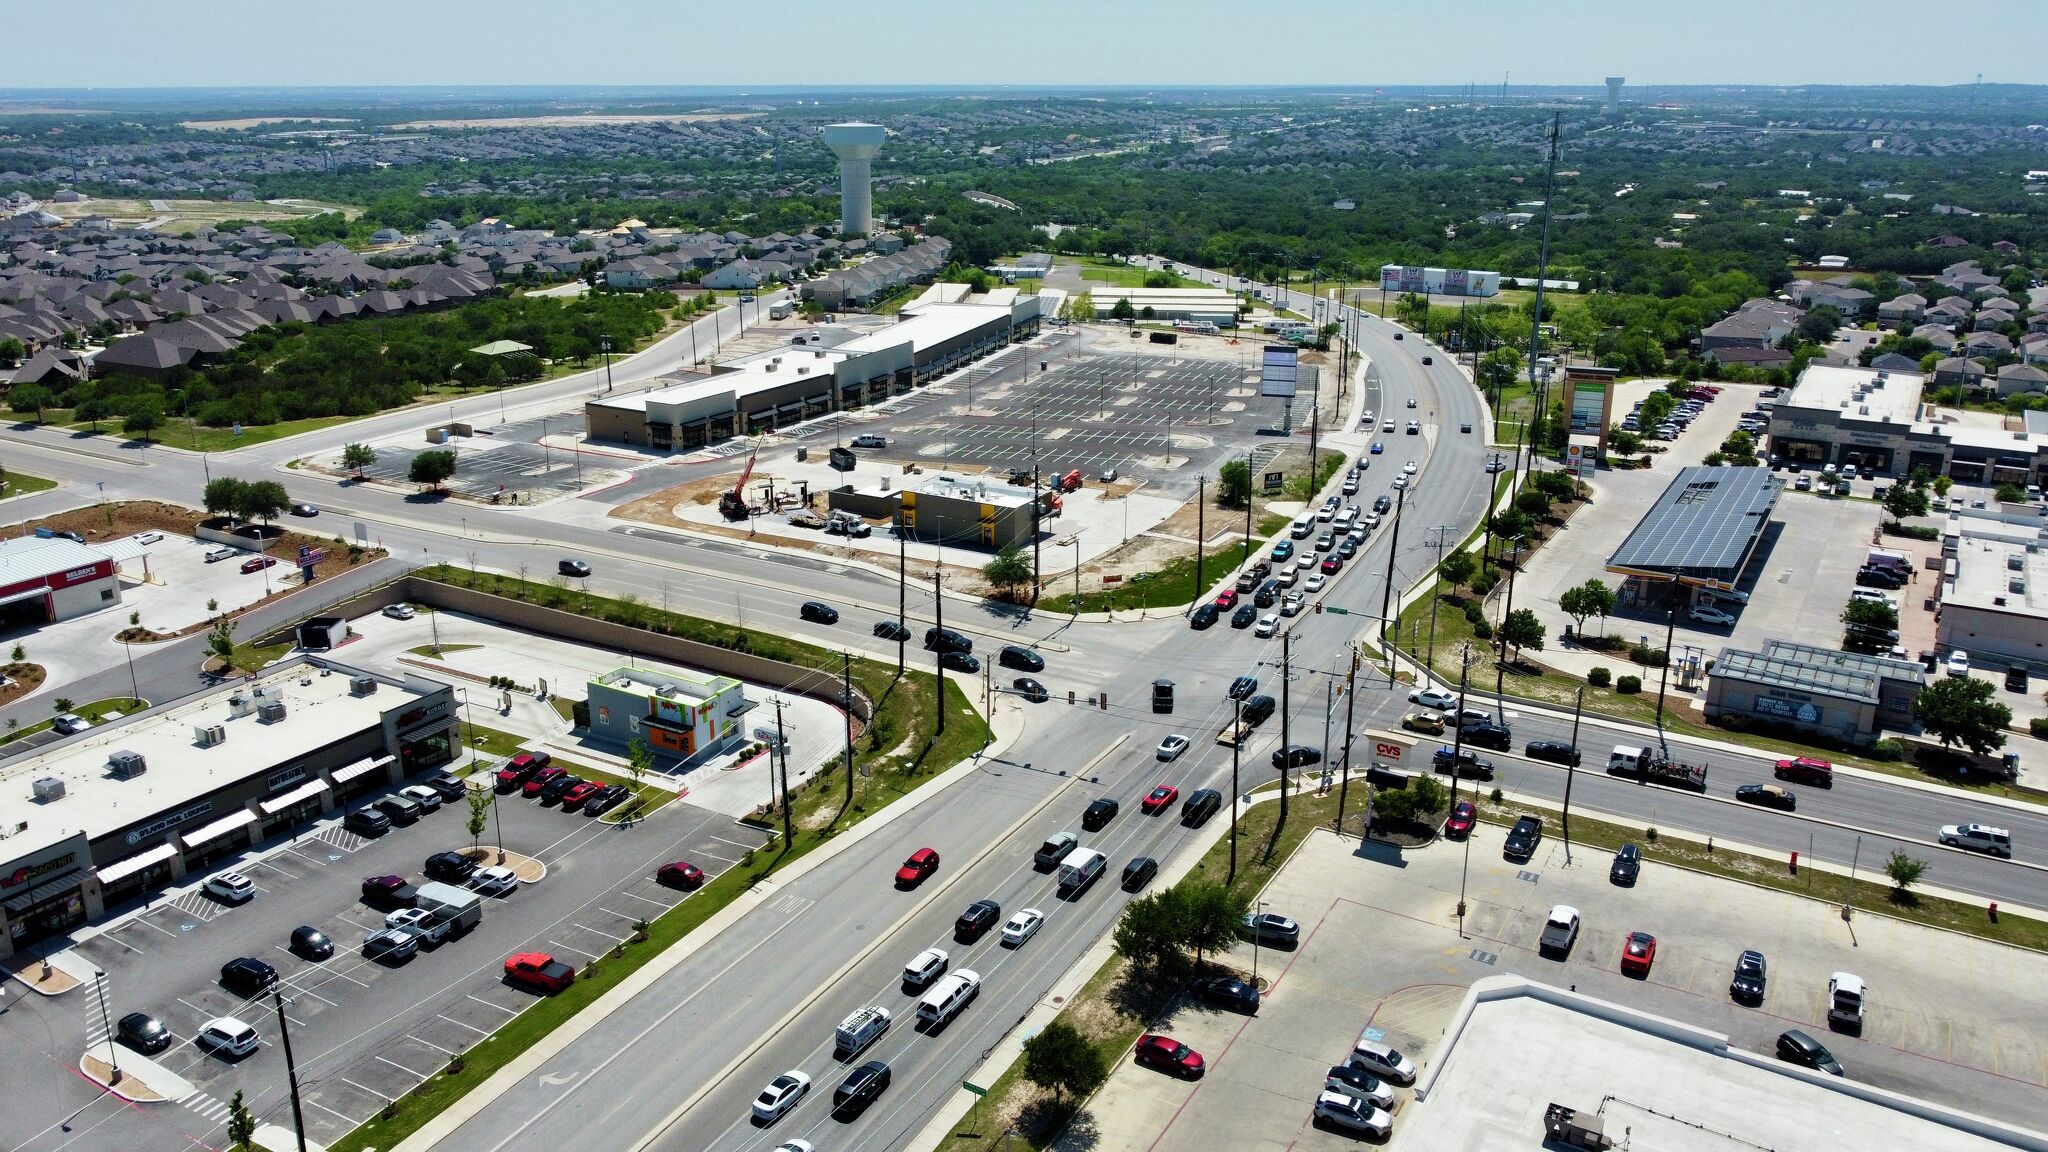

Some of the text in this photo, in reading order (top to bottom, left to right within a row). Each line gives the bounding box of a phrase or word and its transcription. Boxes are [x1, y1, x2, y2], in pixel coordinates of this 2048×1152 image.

[1376, 743, 1400, 756] CVS
[166, 815, 182, 827] NAIL
[183, 803, 212, 819] LOUNGE
